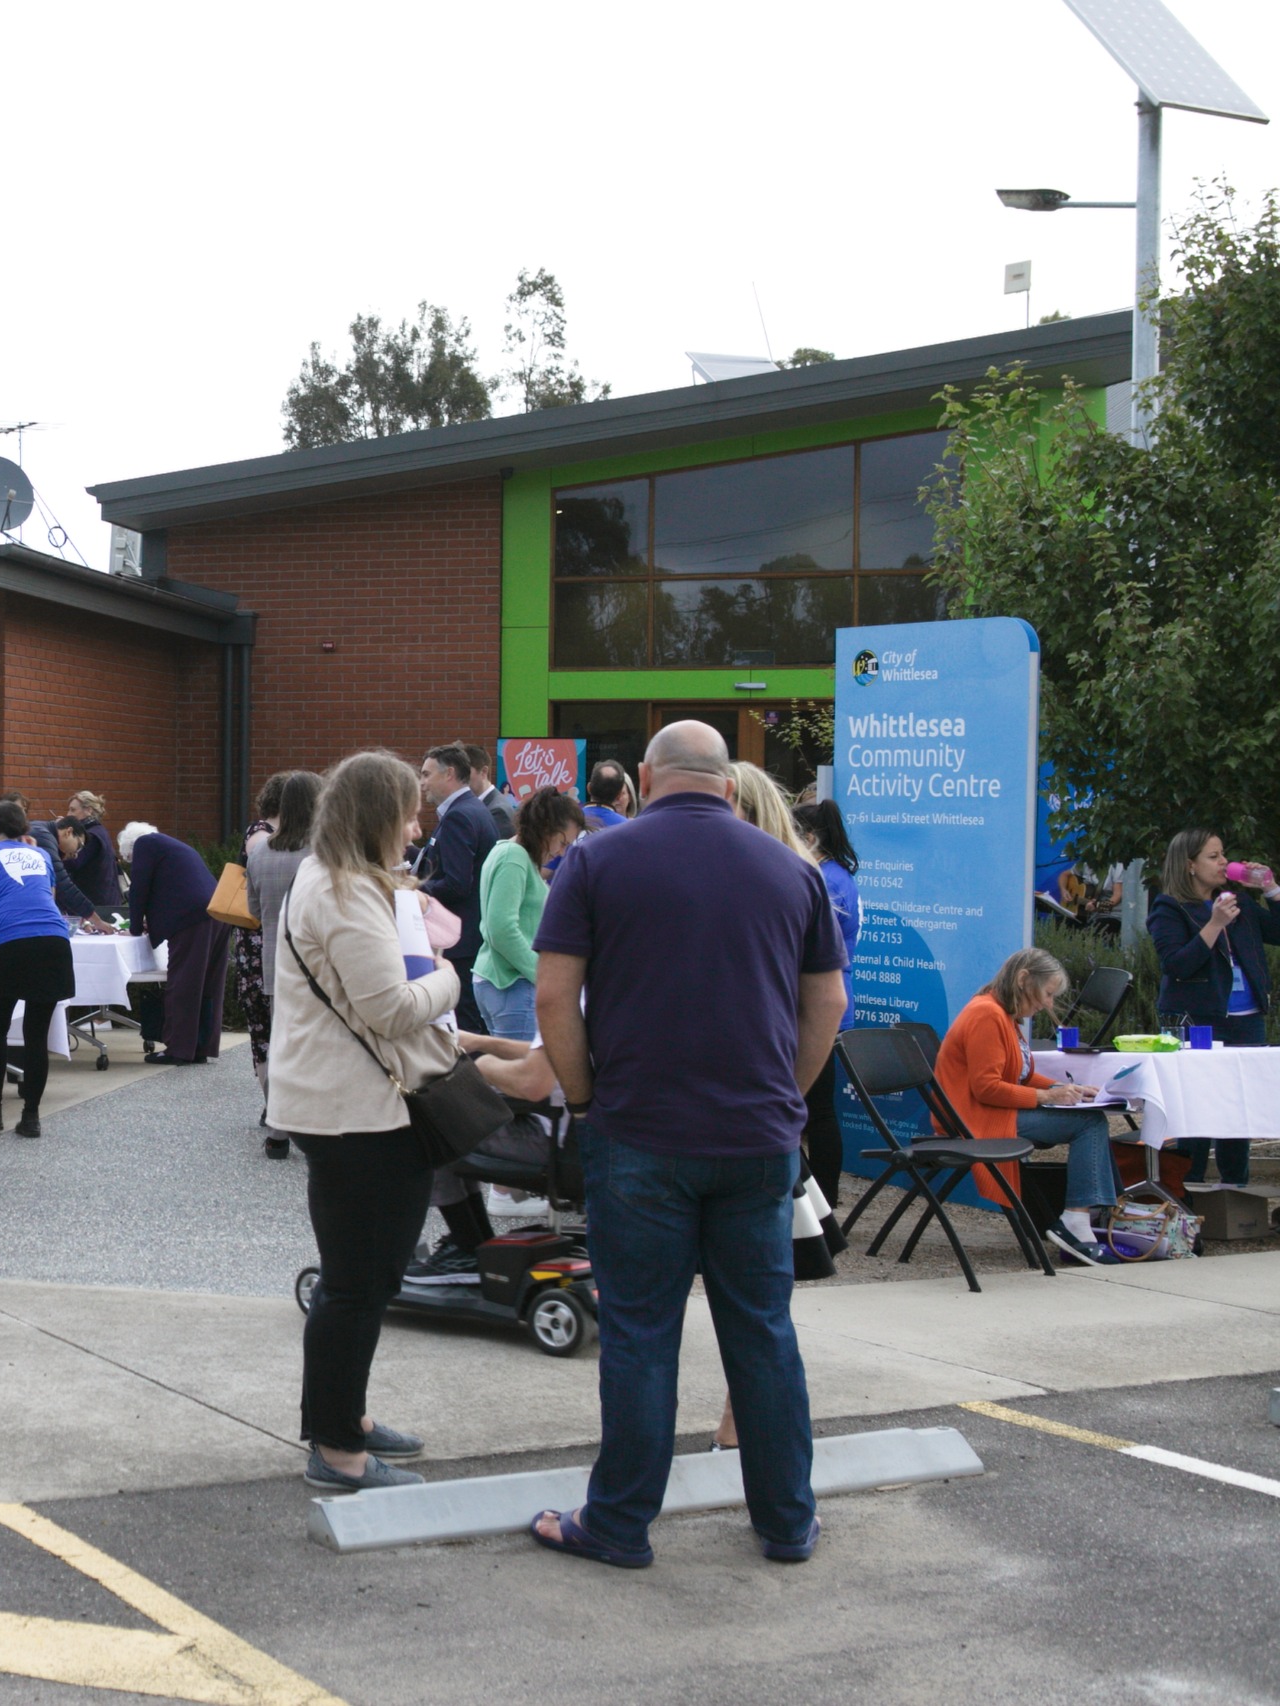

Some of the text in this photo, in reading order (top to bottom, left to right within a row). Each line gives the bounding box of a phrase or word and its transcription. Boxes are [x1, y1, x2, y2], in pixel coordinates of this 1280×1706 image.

[882, 649, 917, 667] City of
[882, 668, 938, 682] Whittlesea
[848, 713, 966, 739] Whittlesea
[512, 741, 555, 778] Let's
[848, 743, 966, 772] Community
[533, 758, 572, 789] talk
[847, 773, 1001, 802] Activity Centre
[846, 812, 984, 825] 57-61 Laurel Street Whittlesea
[5, 851, 32, 865] Let's
[21, 859, 45, 871] talk
[875, 860, 914, 872] Enquiries
[857, 875, 903, 888] 9716 0542
[891, 901, 931, 913] Childcare
[933, 903, 963, 915] Centre
[965, 906, 983, 917] and
[872, 914, 897, 926] Street
[880, 931, 902, 944] 2153
[852, 954, 946, 971] aternal & Child Health
[855, 969, 902, 984] 9404 8888
[854, 993, 919, 1012] ittlesea Library
[855, 1009, 901, 1024] 9716 3028
